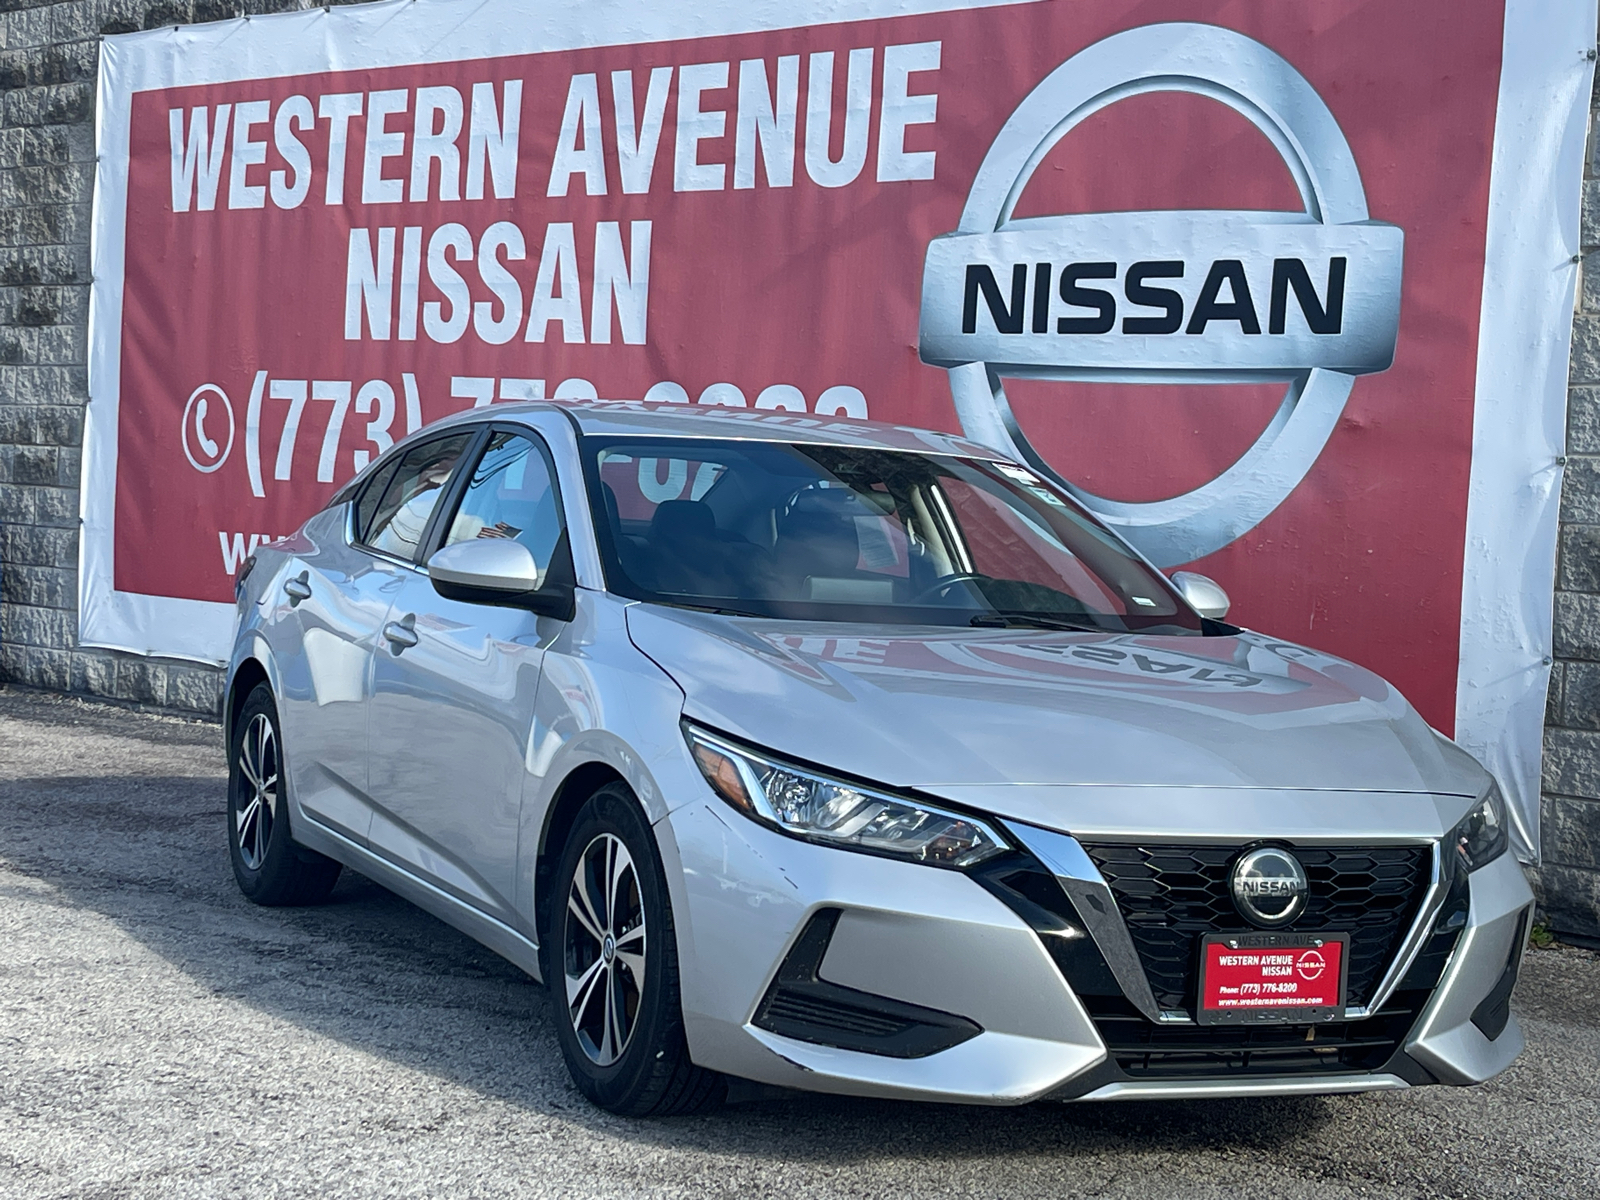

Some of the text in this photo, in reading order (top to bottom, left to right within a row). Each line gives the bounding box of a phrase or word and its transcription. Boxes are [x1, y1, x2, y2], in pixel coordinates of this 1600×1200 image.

[169, 41, 942, 212] WESTERN AVENUE
[345, 220, 652, 345] NISSAN
[962, 257, 1347, 334] NISSAN
[1243, 881, 1299, 893] NISSAN
[1239, 935, 1315, 946] WESTERN AVE
[1219, 955, 1294, 966] WESTERN AVENUE
[1262, 966, 1293, 976] NISSAN
[1219, 982, 1298, 996] Phone: (773) 776-8200
[1218, 997, 1323, 1006] www.westernavenissan.com
